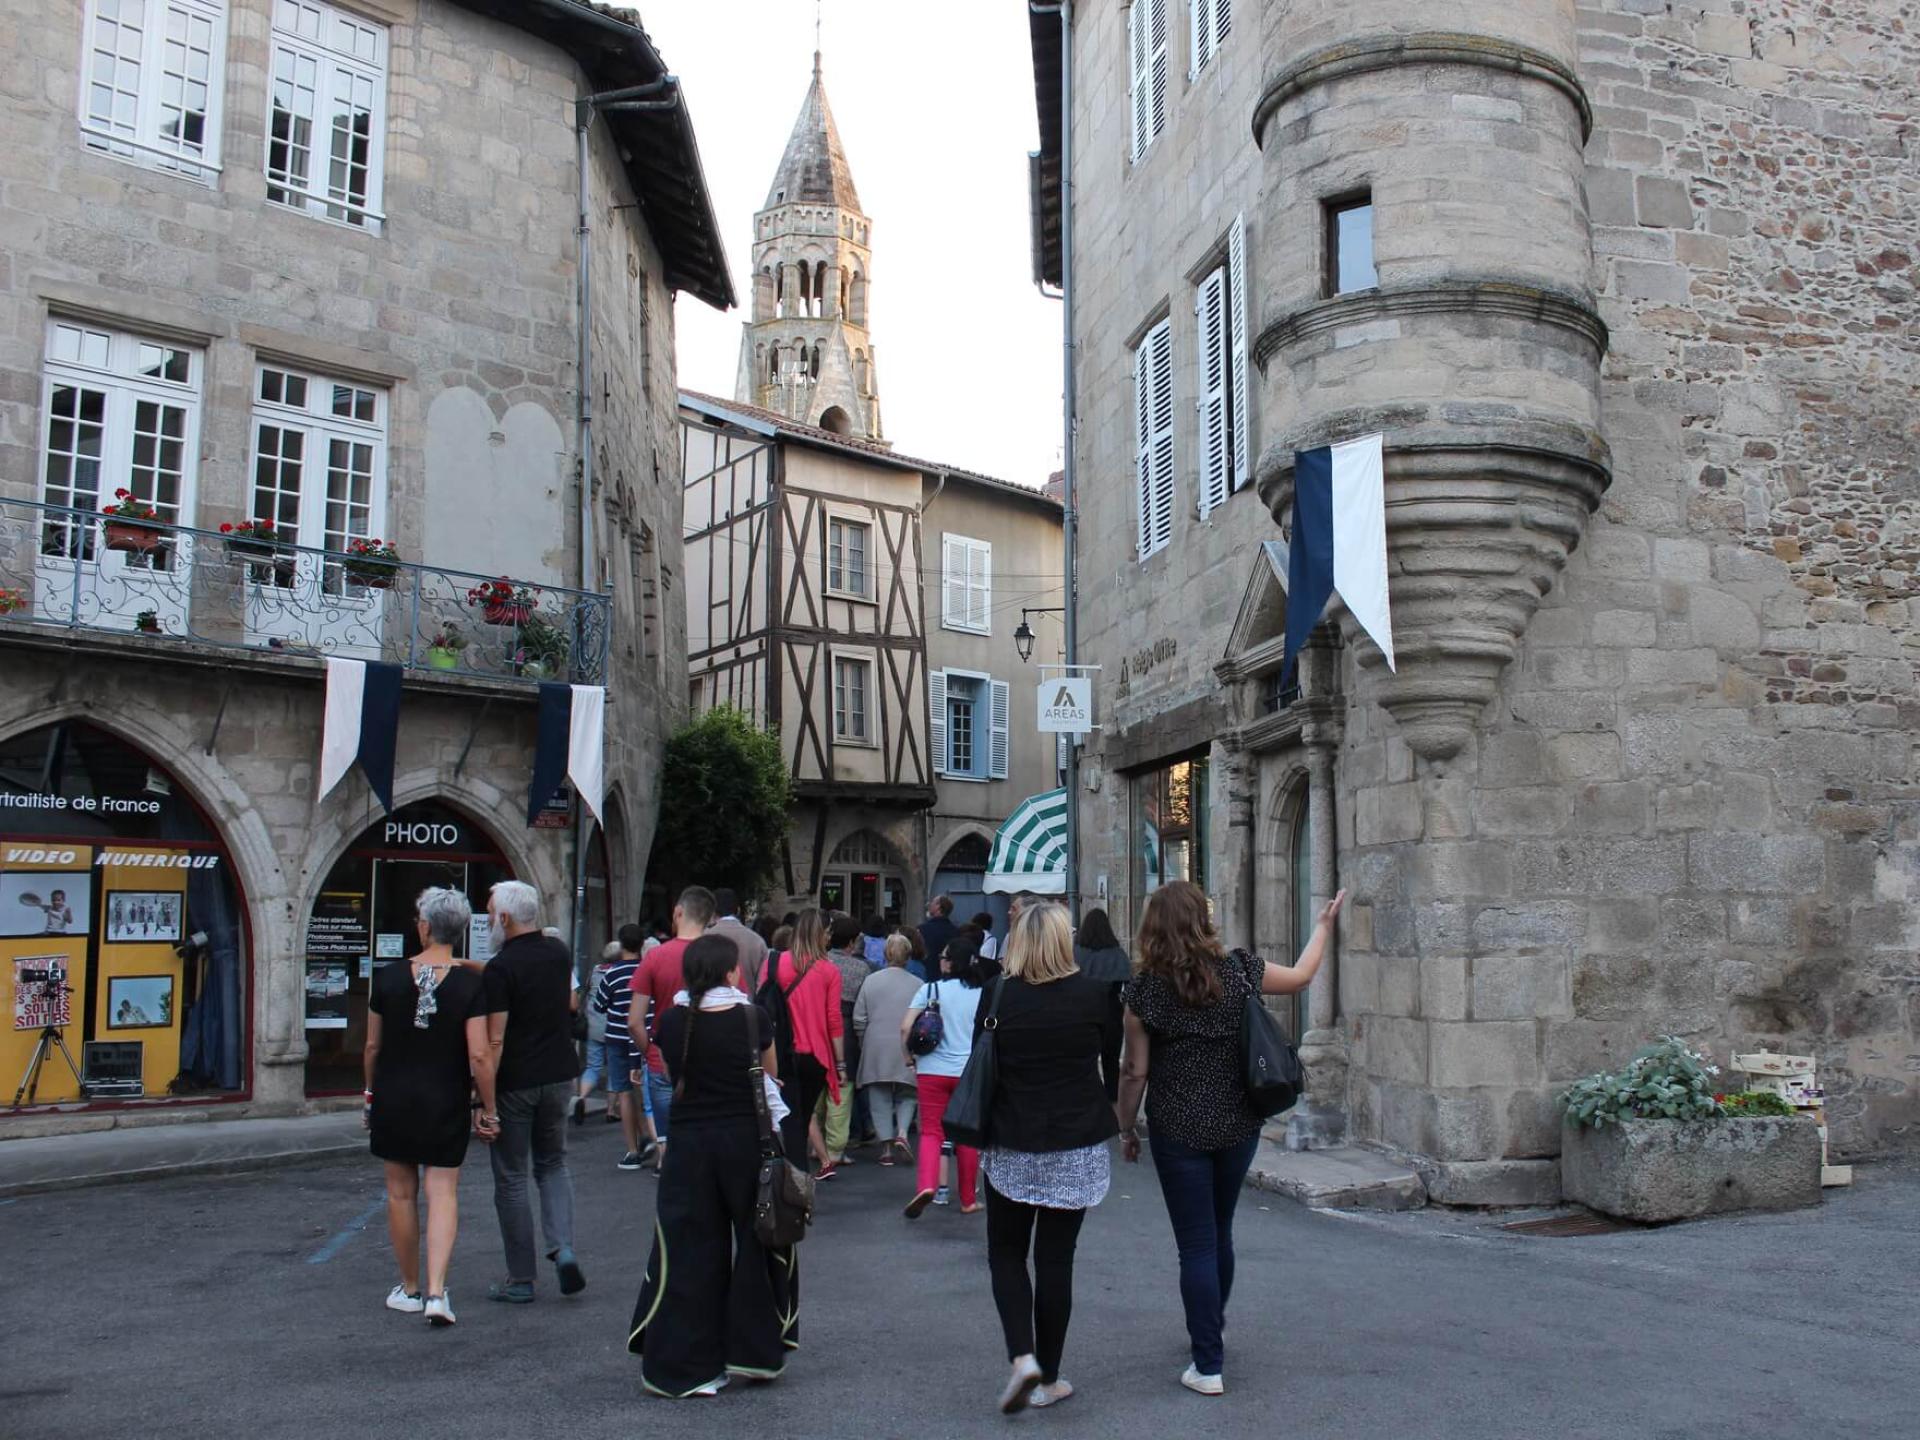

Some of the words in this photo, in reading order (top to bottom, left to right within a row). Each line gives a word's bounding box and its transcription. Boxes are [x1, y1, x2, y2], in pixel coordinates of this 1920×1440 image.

[1045, 708, 1085, 719] AREAS
[72, 795, 97, 810] de
[102, 796, 160, 813] France
[385, 822, 458, 845] PHOTO
[6, 848, 76, 864] VIDEO
[95, 852, 219, 869] NUMERIQUE
